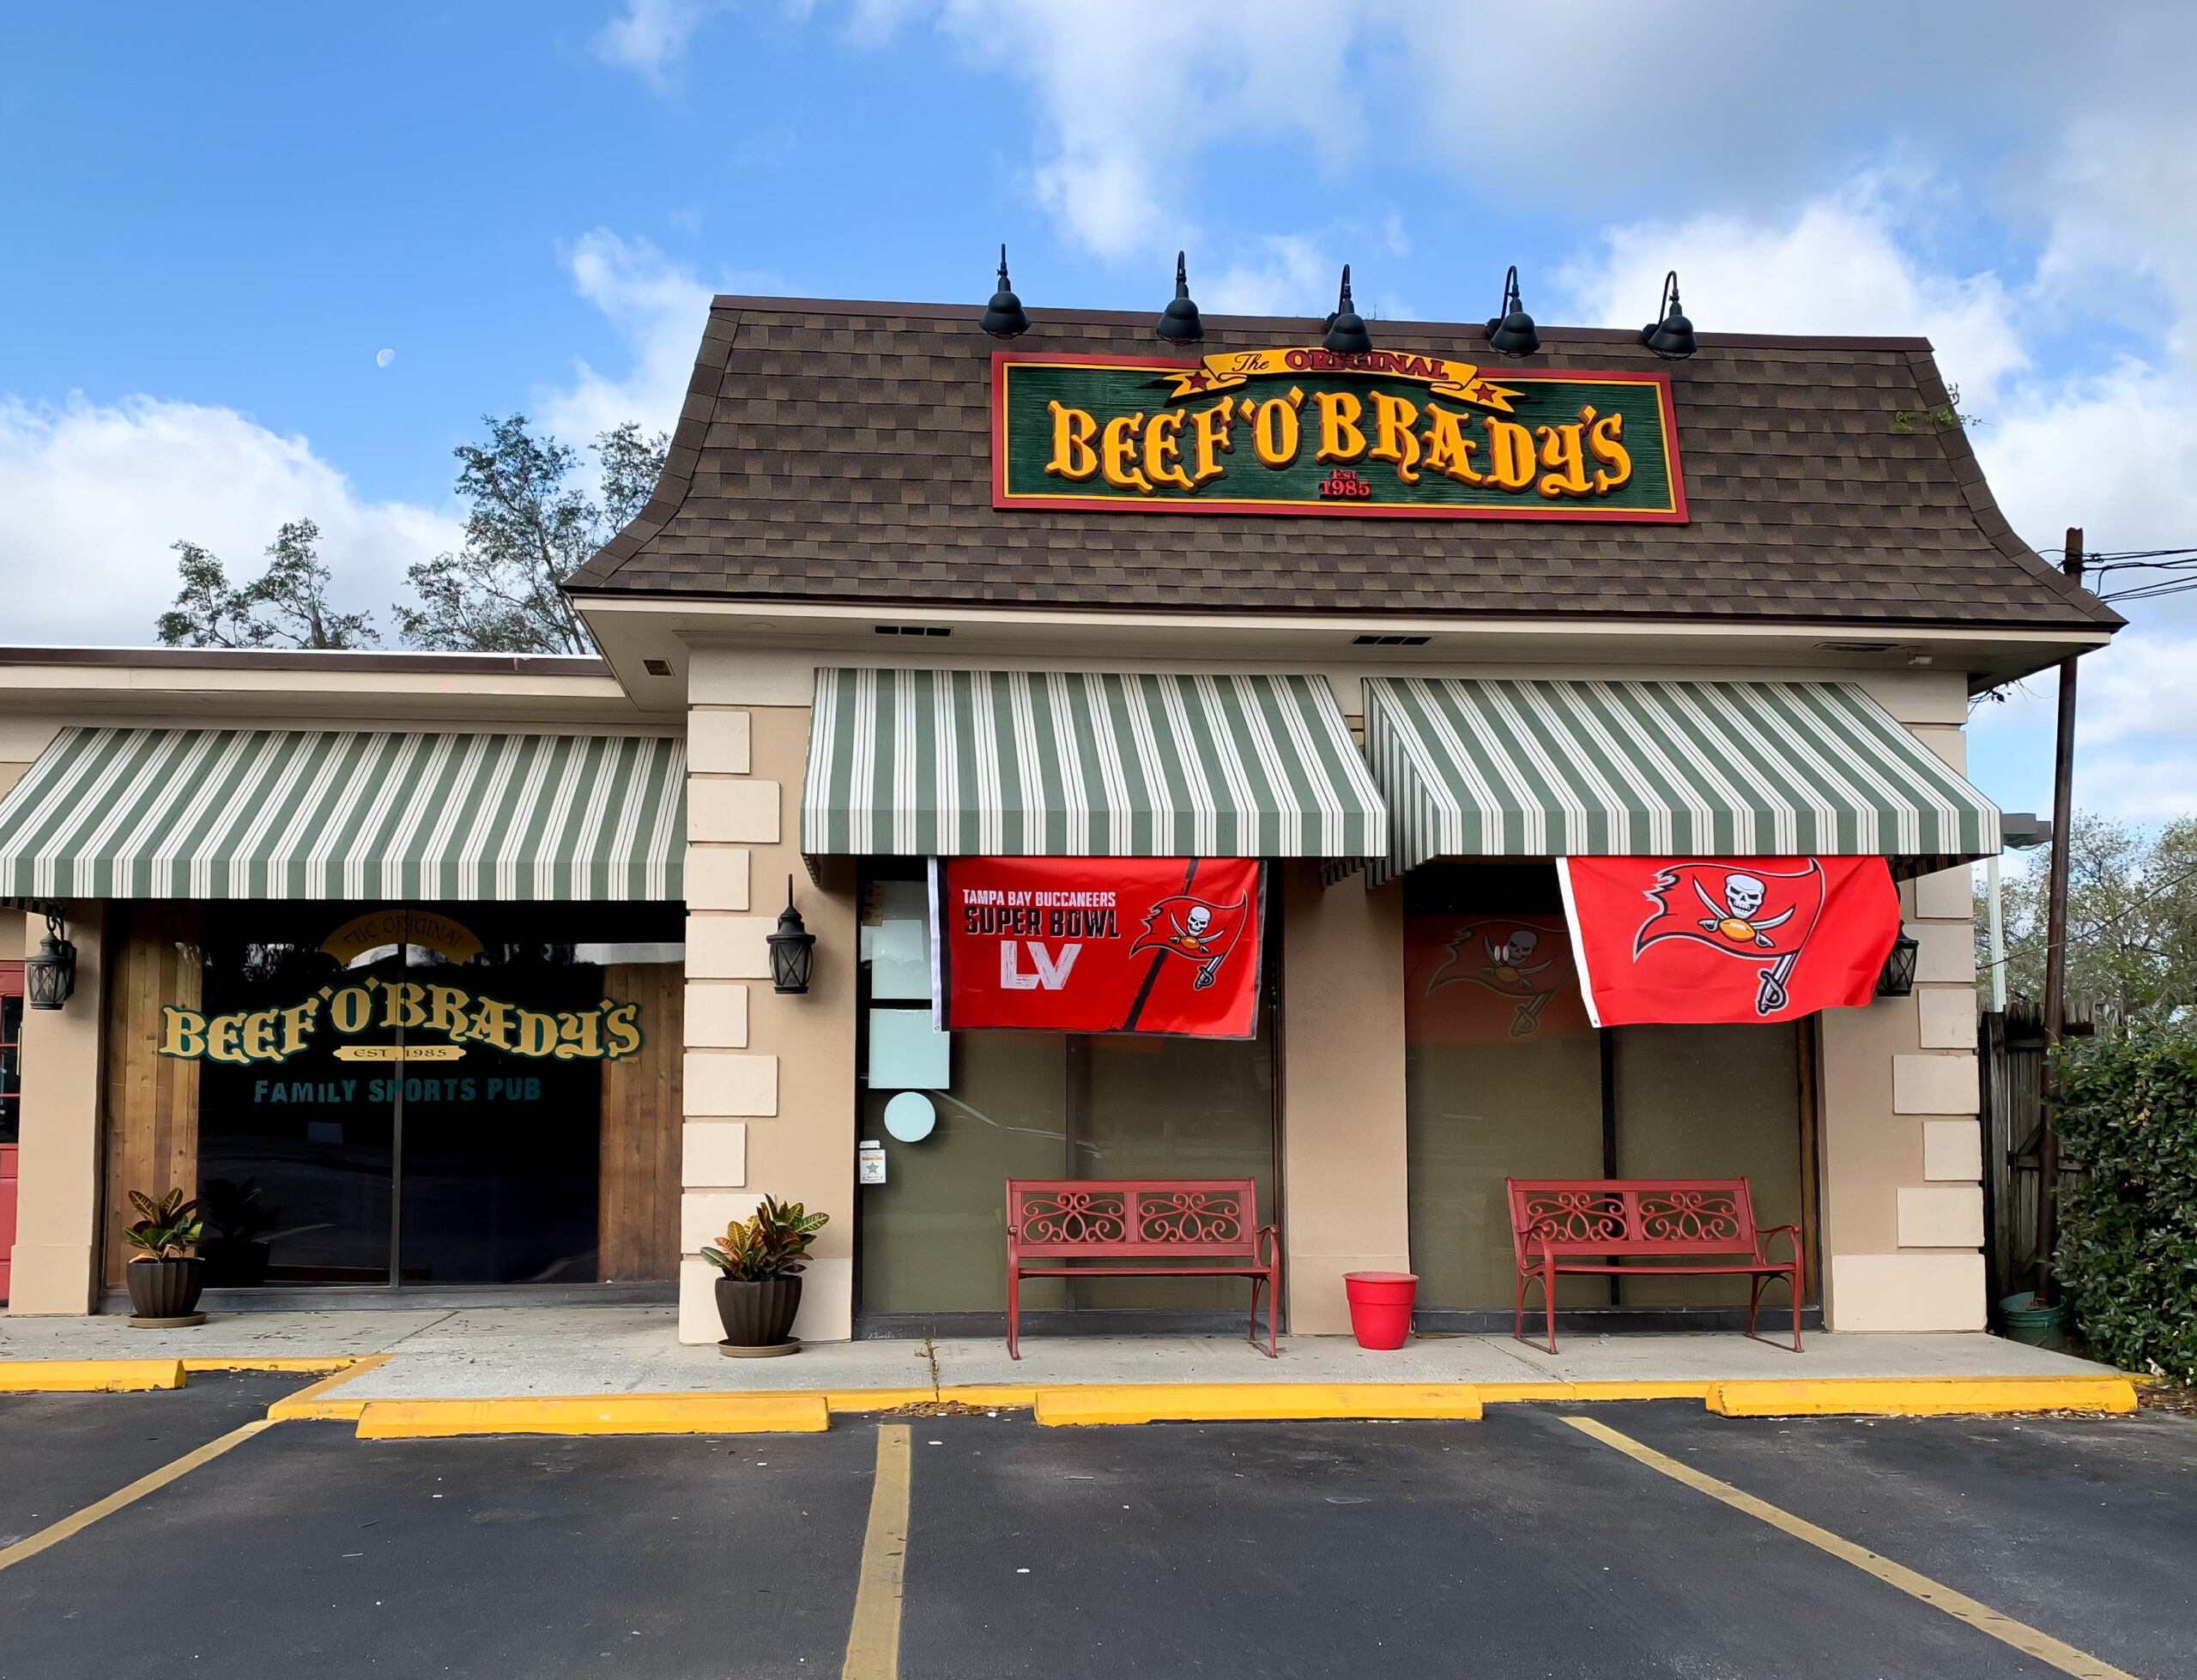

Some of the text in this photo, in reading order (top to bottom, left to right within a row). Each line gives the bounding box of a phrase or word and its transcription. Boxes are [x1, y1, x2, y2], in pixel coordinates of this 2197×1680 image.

[1232, 349, 1450, 380] The ORIGINAL
[1331, 468, 1358, 480] Est
[1319, 480, 1371, 499] 1985
[963, 889, 1117, 908] TAMPA BAY BUCCANEERS
[383, 916, 464, 947] ORIGINAL
[964, 905, 1122, 940] SUPER BOWL
[1001, 940, 1083, 990] LV
[405, 1048, 448, 1058] 1985
[254, 1078, 542, 1103] FAMILY SPORTS PUB
